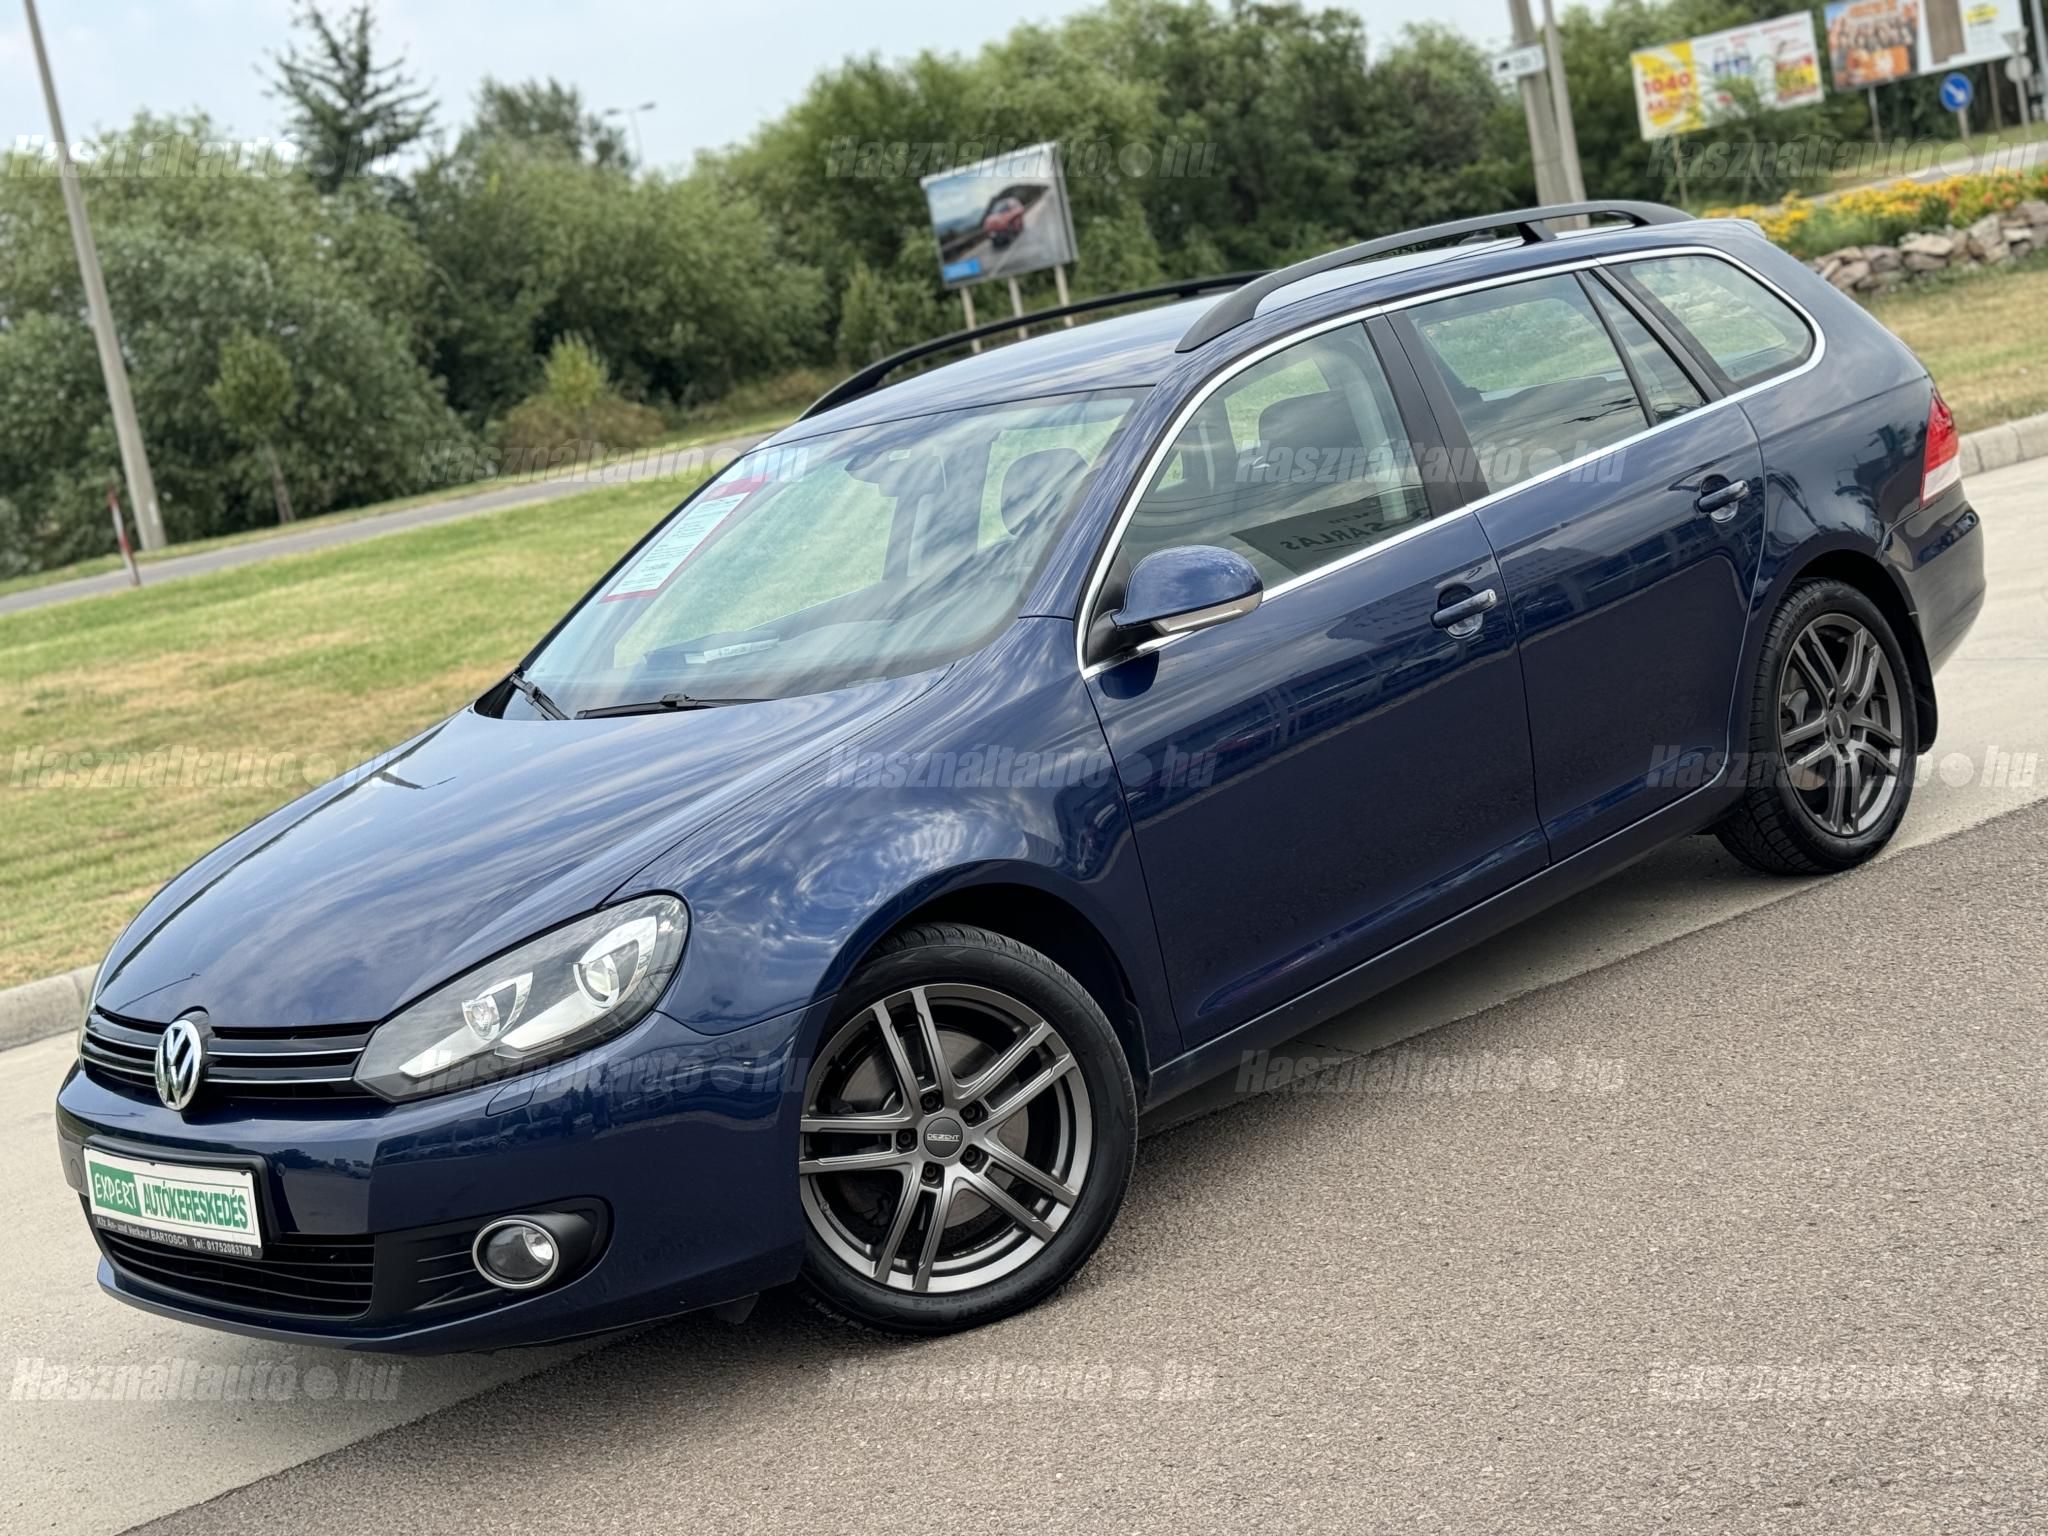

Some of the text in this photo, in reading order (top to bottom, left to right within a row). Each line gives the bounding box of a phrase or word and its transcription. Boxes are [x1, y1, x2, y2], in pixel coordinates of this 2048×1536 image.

[94, 1172, 248, 1230] EXPERT AUTÓKERESKEDÉS
[150, 1229, 188, 1246] BARTOSCH
